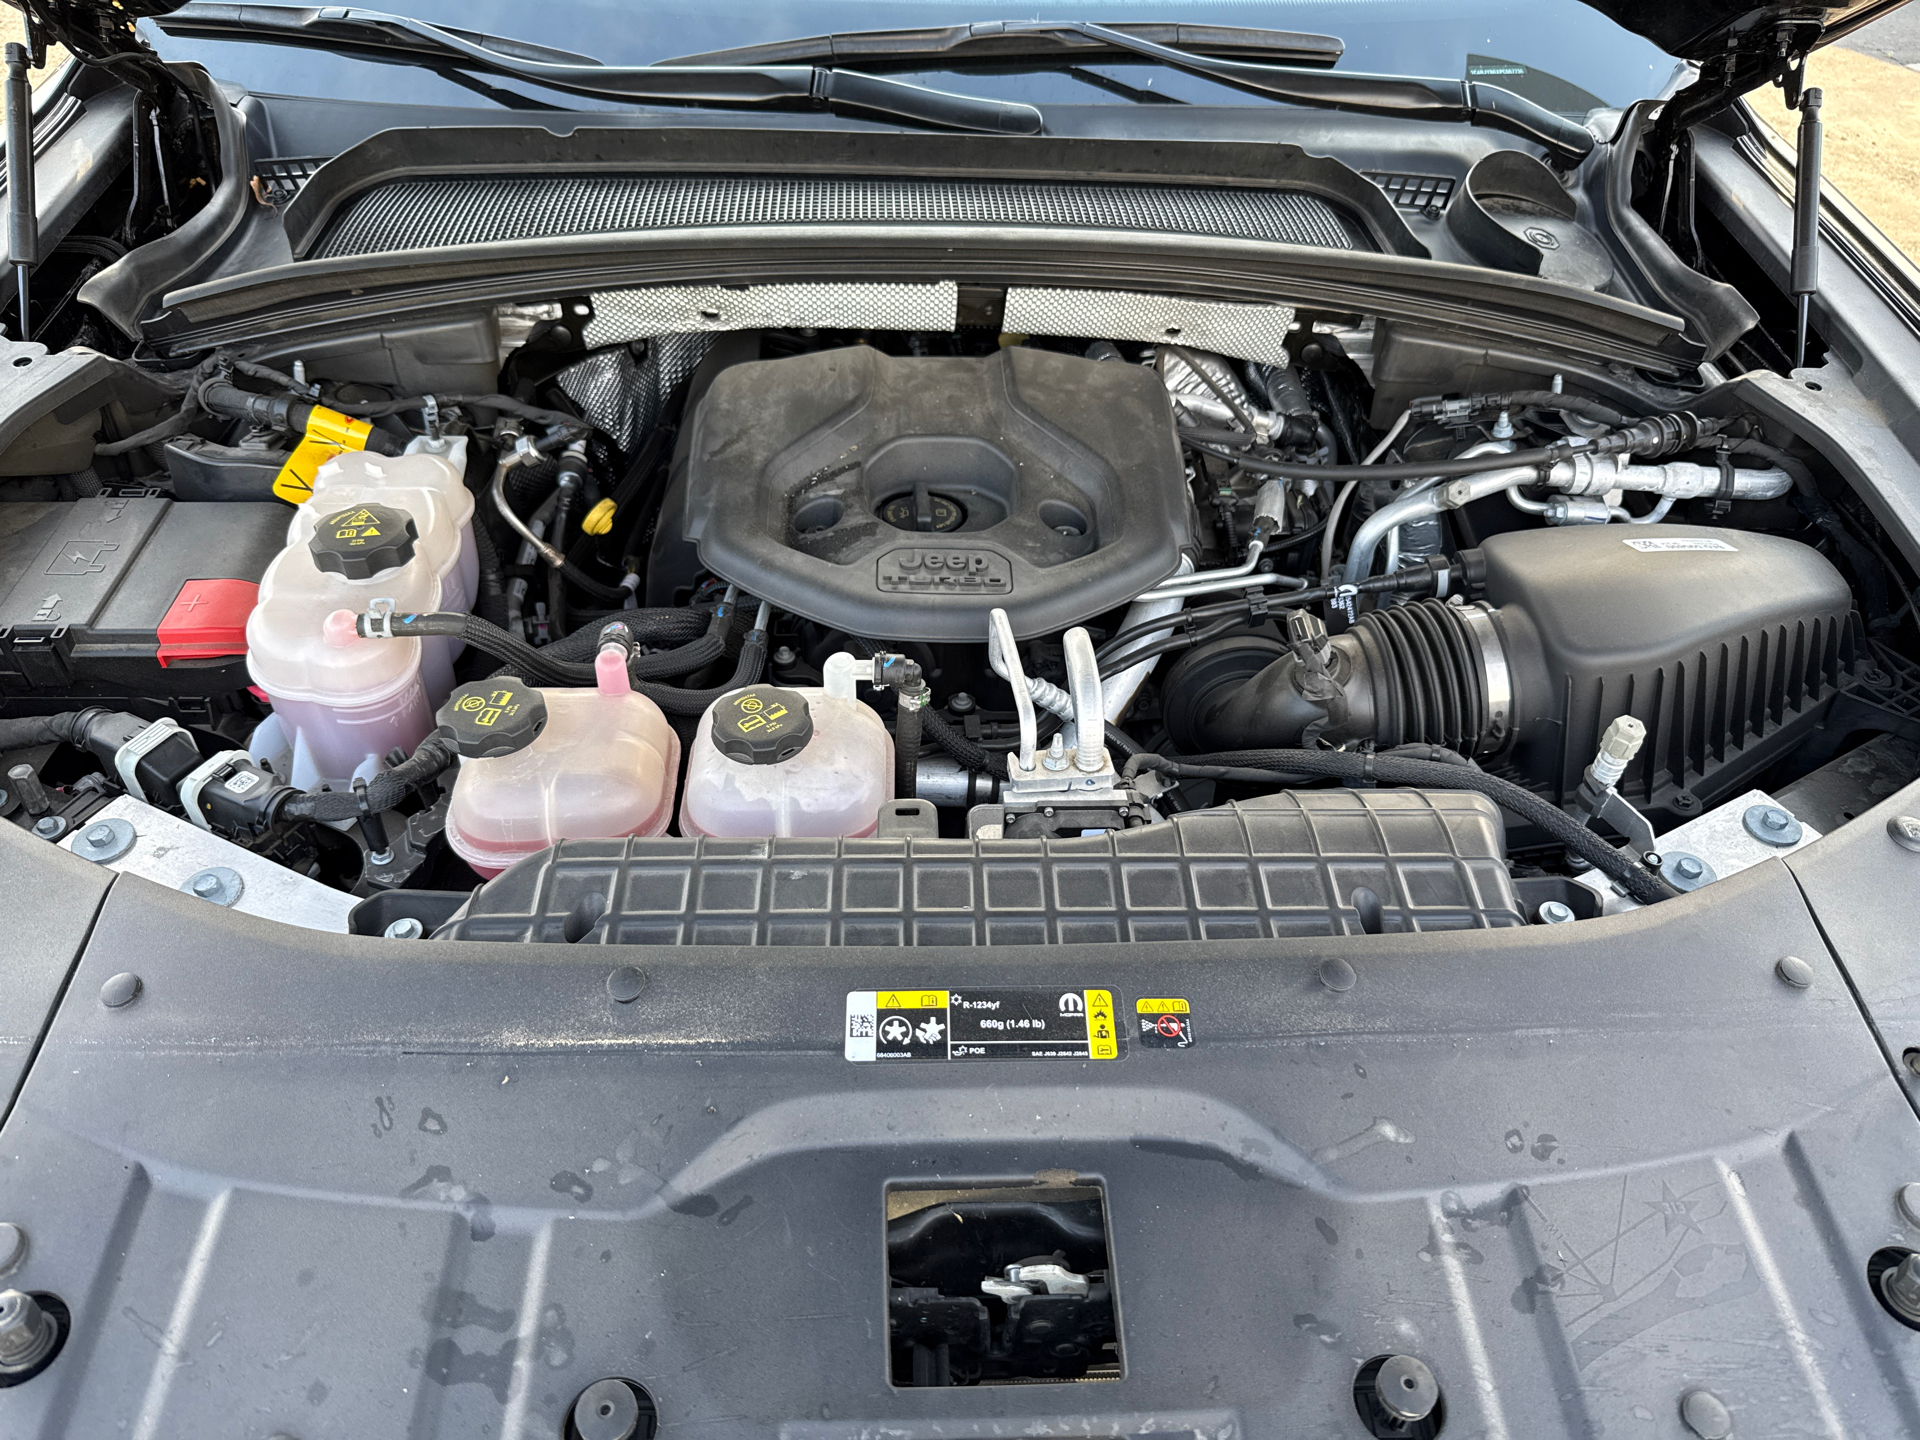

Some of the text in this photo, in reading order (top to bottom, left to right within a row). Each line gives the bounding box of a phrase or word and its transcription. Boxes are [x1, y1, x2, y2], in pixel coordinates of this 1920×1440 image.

[899, 549, 989, 576] Jeep
[883, 576, 1007, 588] TURBO
[962, 1001, 1000, 1010] R-1234yf
[980, 1019, 1046, 1030] 660g (1.46 lb)
[1661, 1201, 1687, 1215] 313
